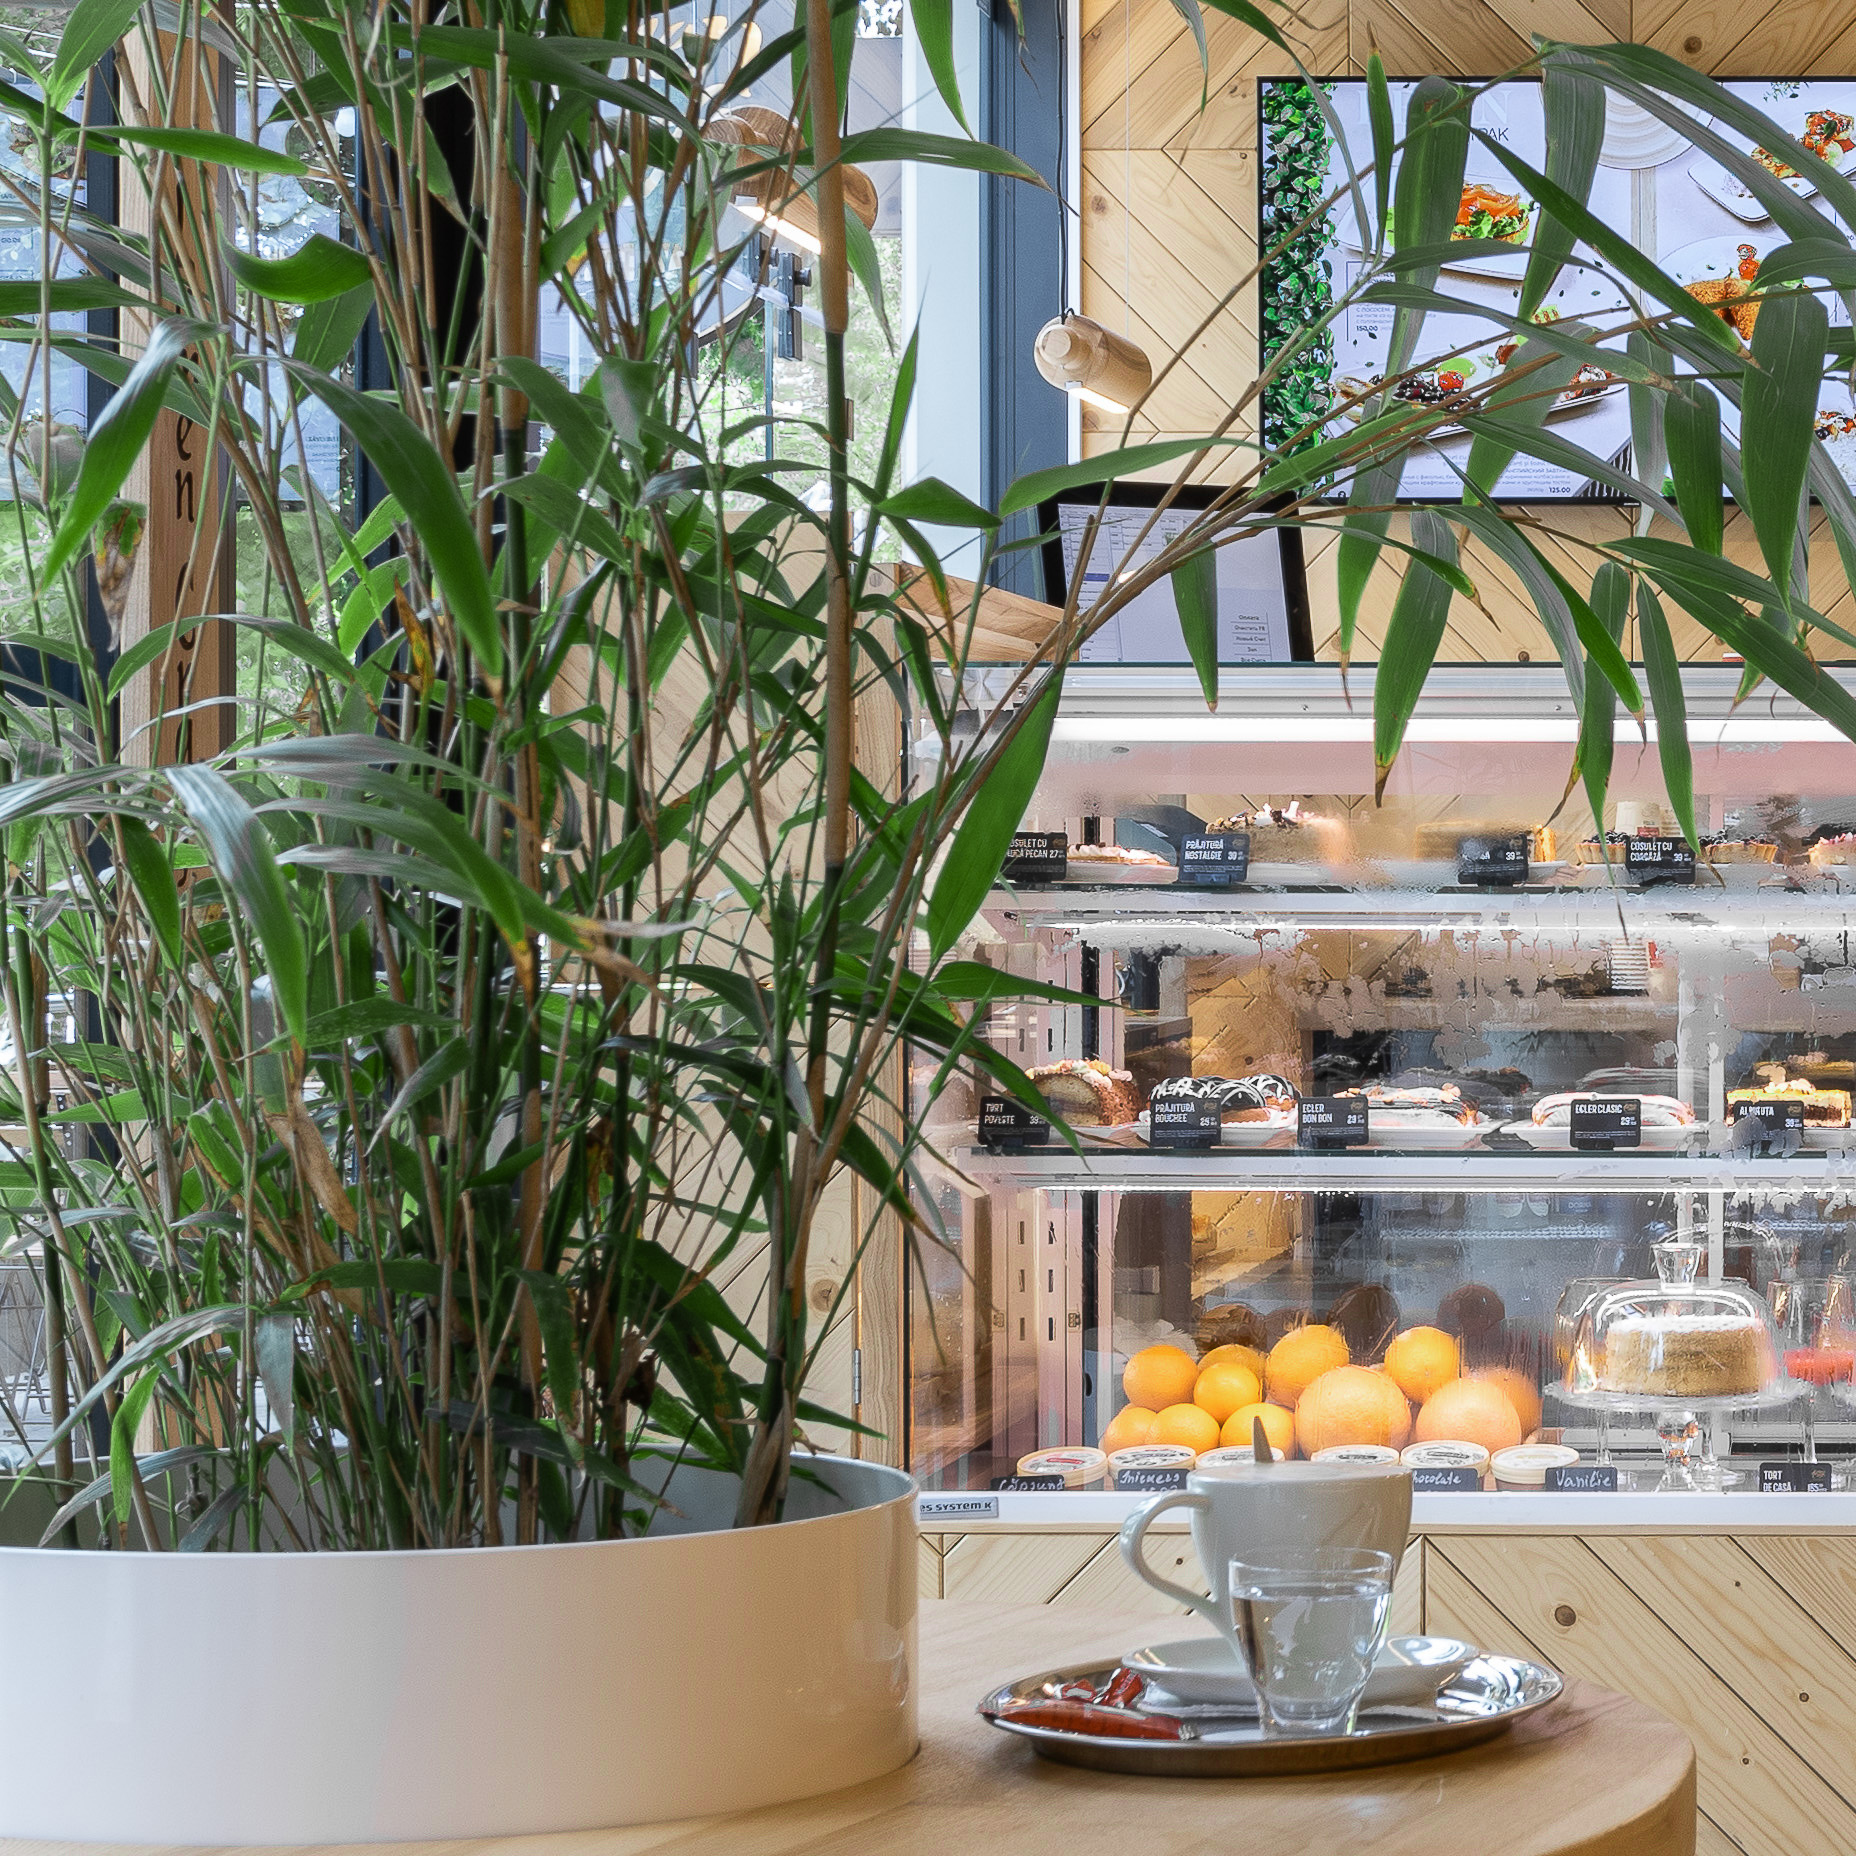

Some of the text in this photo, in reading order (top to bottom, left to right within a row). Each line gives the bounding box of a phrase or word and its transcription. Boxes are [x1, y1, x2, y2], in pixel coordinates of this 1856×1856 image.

[1549, 486, 1571, 494] 125.00
[1050, 850, 1058, 858] 27
[985, 1103, 1004, 1112] TORT
[1302, 1103, 1325, 1113] ECLER
[1575, 1104, 1622, 1114] ECLER CLASIC
[1302, 1114, 1317, 1123] BON
[1763, 1470, 1783, 1480] TORT
